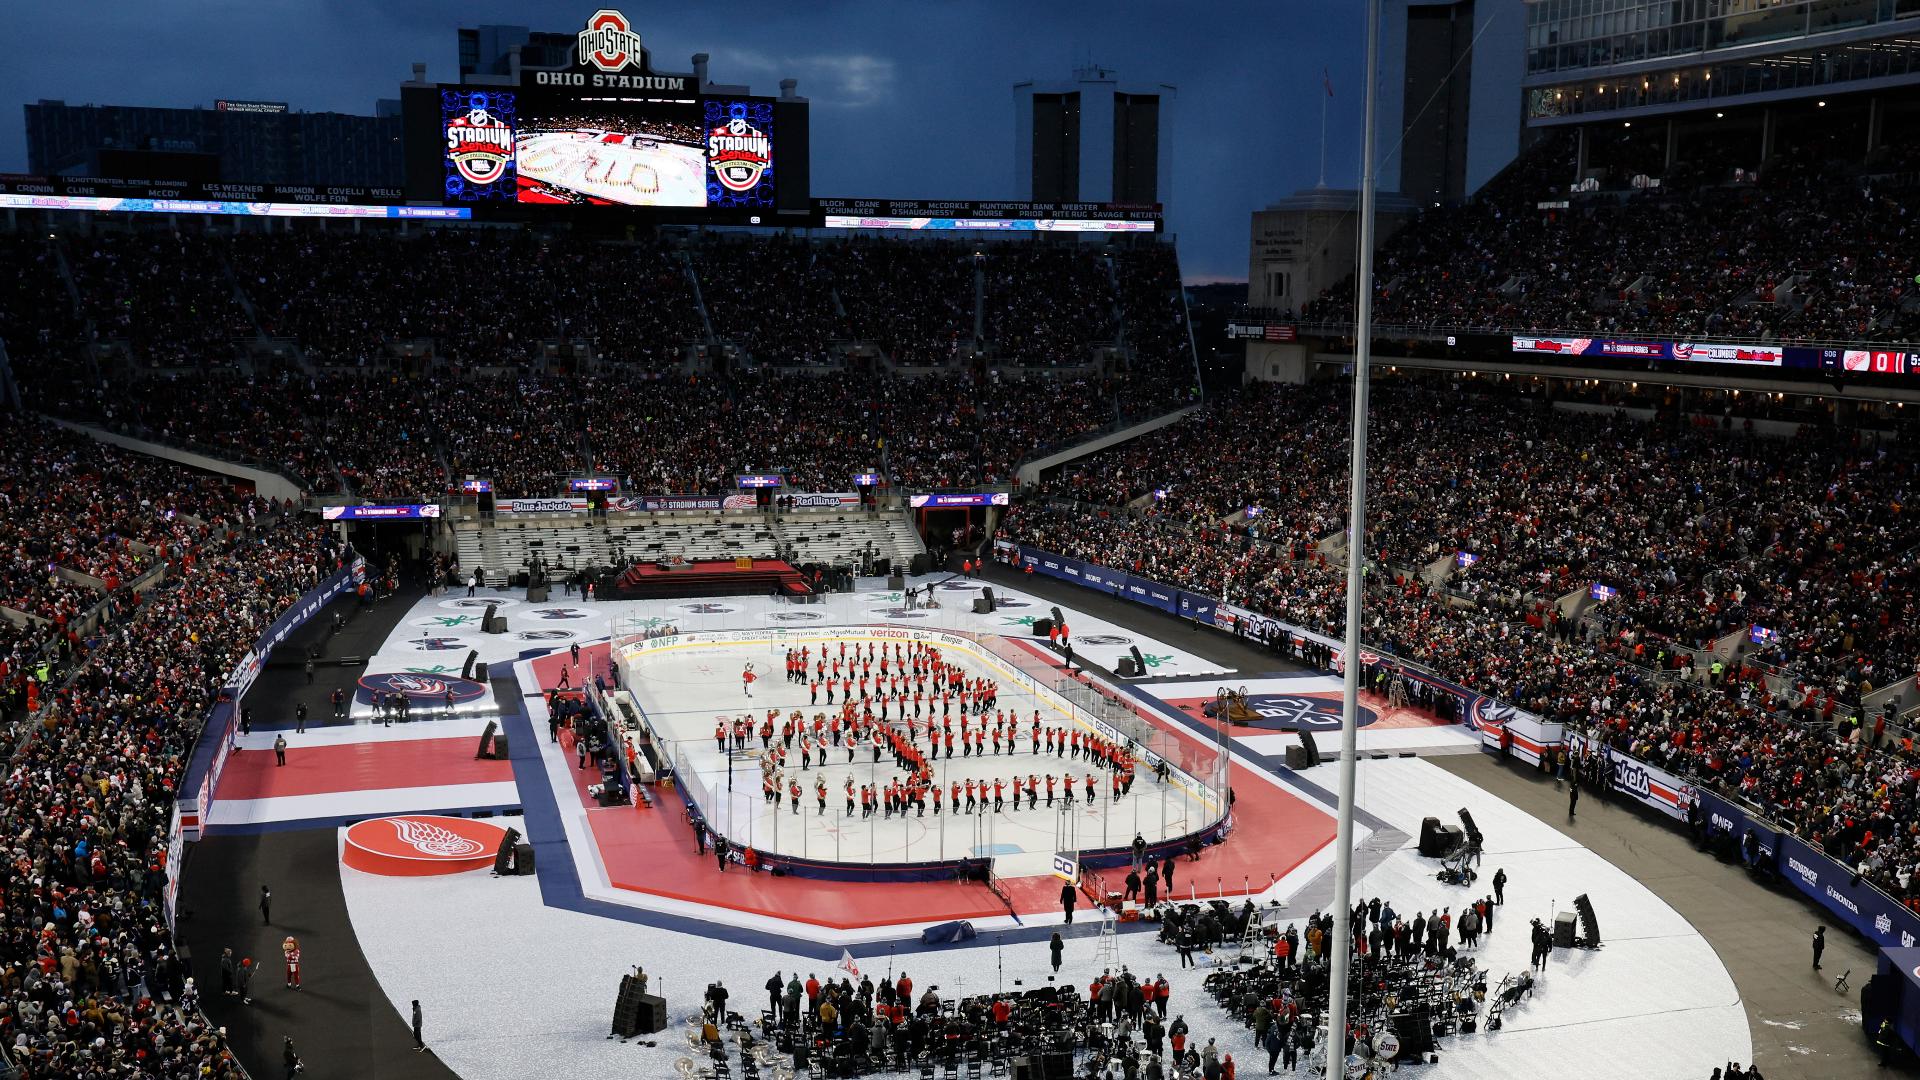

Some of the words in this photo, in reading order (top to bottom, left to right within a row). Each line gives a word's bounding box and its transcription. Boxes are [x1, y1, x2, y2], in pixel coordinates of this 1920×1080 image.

[581, 31, 604, 63] OHIO
[606, 28, 640, 67] STATE
[537, 71, 585, 86] OHIO
[592, 74, 685, 91] STADIUM
[448, 127, 511, 151] STADIUM
[460, 141, 501, 154] Series
[709, 136, 768, 159] STADIUM
[719, 149, 758, 162] Series
[16, 184, 55, 193] CRONIN
[66, 186, 97, 195] CLINE
[202, 183, 220, 191] LES
[222, 184, 264, 193] WEXNER
[274, 186, 315, 194] HARMON
[327, 187, 365, 196] COVELLI
[370, 188, 402, 197] WELLS
[211, 191, 257, 200] WANDELL
[854, 200, 880, 208] CRANE
[825, 207, 875, 215] SCHUMAKER
[1130, 211, 1163, 219] NETJETS
[1708, 347, 1737, 359] COLUMBUS
[1824, 350, 1837, 358] SOG
[1876, 352, 1888, 371] 0
[512, 501, 535, 512] Blue
[535, 501, 572, 512] Jackets
[668, 501, 697, 509] STADIUM
[697, 500, 719, 508] SERIES
[795, 496, 812, 506] Red
[812, 496, 842, 506] Wings
[1130, 585, 1146, 596] verizon
[870, 629, 909, 638] verizon
[658, 636, 679, 647] NFP
[1096, 720, 1114, 740] GEICO
[1613, 759, 1651, 799] ckets
[1718, 815, 1733, 832] NFP
[1832, 889, 1859, 915] HONDA
[1901, 930, 1916, 947] CAT
[1380, 1041, 1398, 1052] STATE
[1349, 1062, 1367, 1074] STATE
